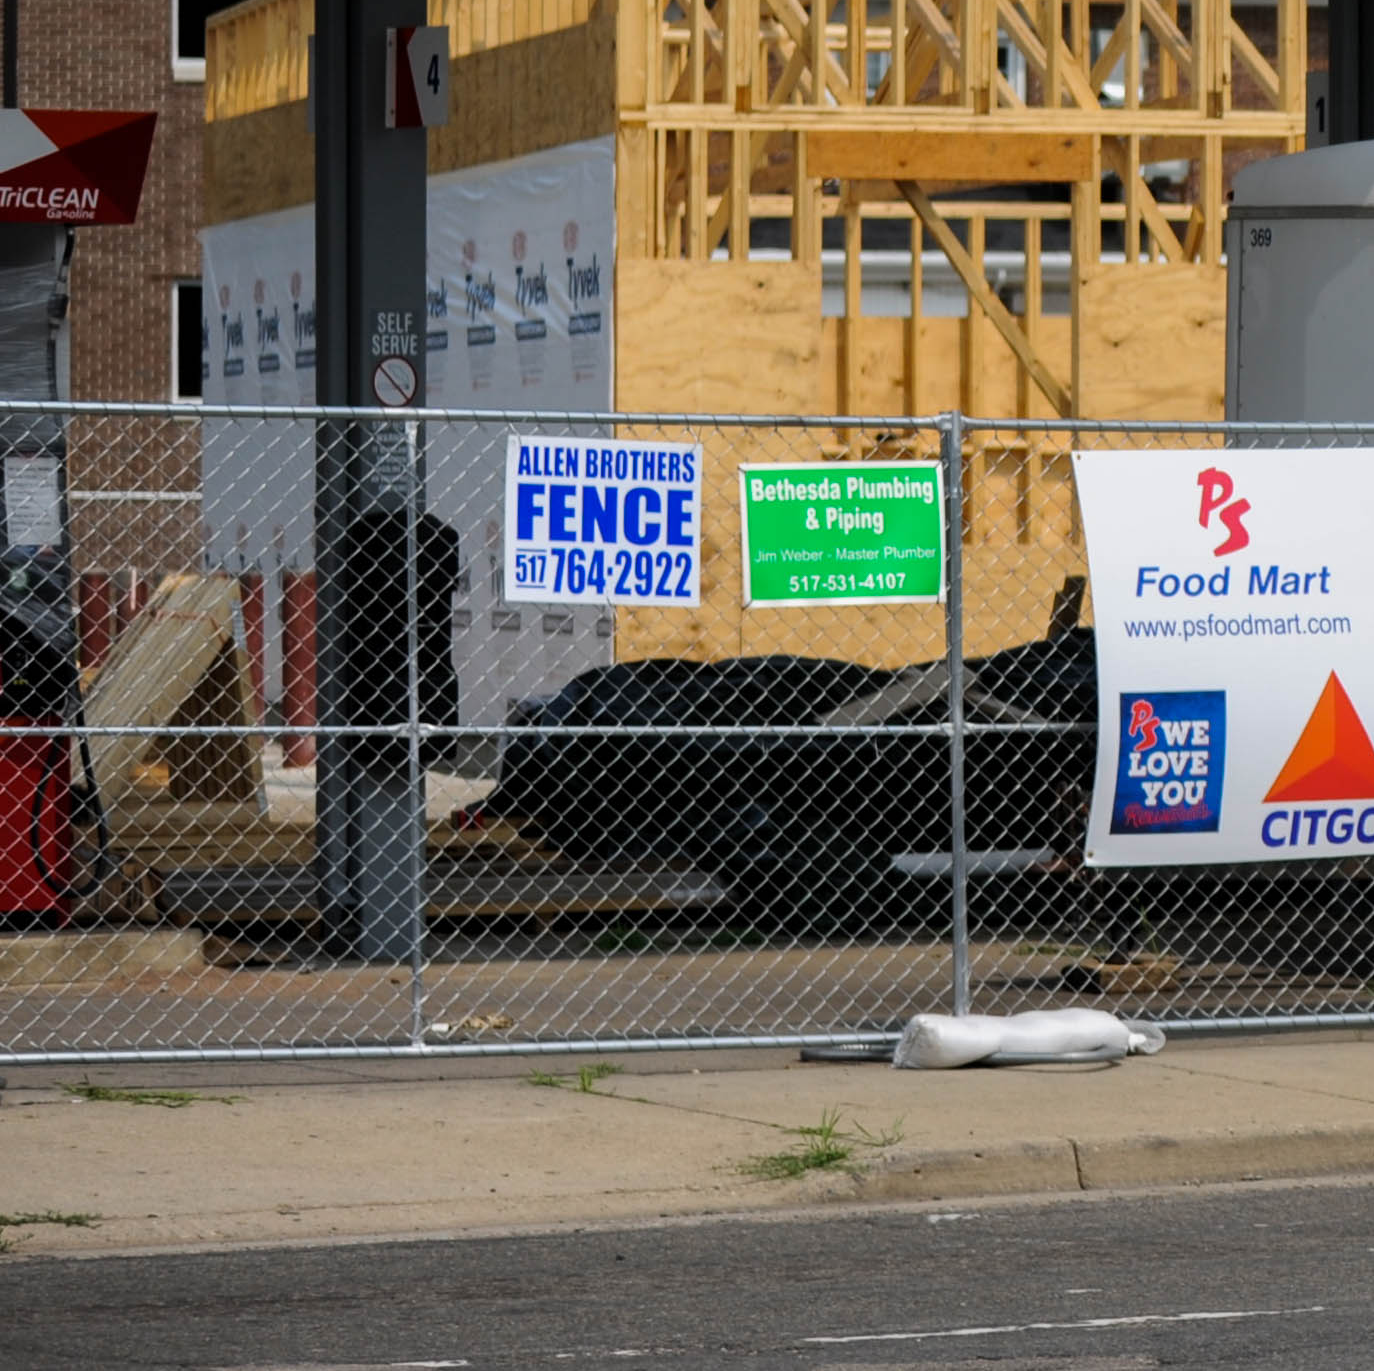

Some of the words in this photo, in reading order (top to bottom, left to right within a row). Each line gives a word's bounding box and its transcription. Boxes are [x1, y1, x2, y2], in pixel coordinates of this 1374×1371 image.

[425, 53, 441, 95] 4
[1315, 96, 1326, 133] 1
[0, 186, 99, 208] TriCLEAN
[46, 208, 95, 220] Gasoline
[1250, 228, 1272, 247] 369
[515, 261, 548, 317] Tyvek
[566, 252, 600, 311] Tyvek
[377, 312, 413, 333] SELF
[372, 334, 418, 356] SERVE
[517, 445, 579, 478] ALLEN
[585, 448, 695, 483] BROTHERS
[750, 477, 841, 502] Bethesda
[846, 476, 934, 505] Plumbing
[516, 482, 694, 547] FENCE
[805, 507, 820, 530] &
[825, 506, 884, 535] Piping
[755, 548, 777, 563] Jim
[781, 548, 824, 562] Weber
[835, 547, 879, 561] Master
[883, 545, 937, 559] Plumber
[515, 554, 547, 584] 517
[789, 572, 906, 593] 517-531-4107
[1135, 565, 1231, 598] Food
[1247, 565, 1331, 596] Mart
[1123, 612, 1352, 641] www.psfoodmart.com
[1161, 720, 1210, 746] WE
[1127, 750, 1210, 778] LOVE
[1141, 780, 1208, 807] YOU
